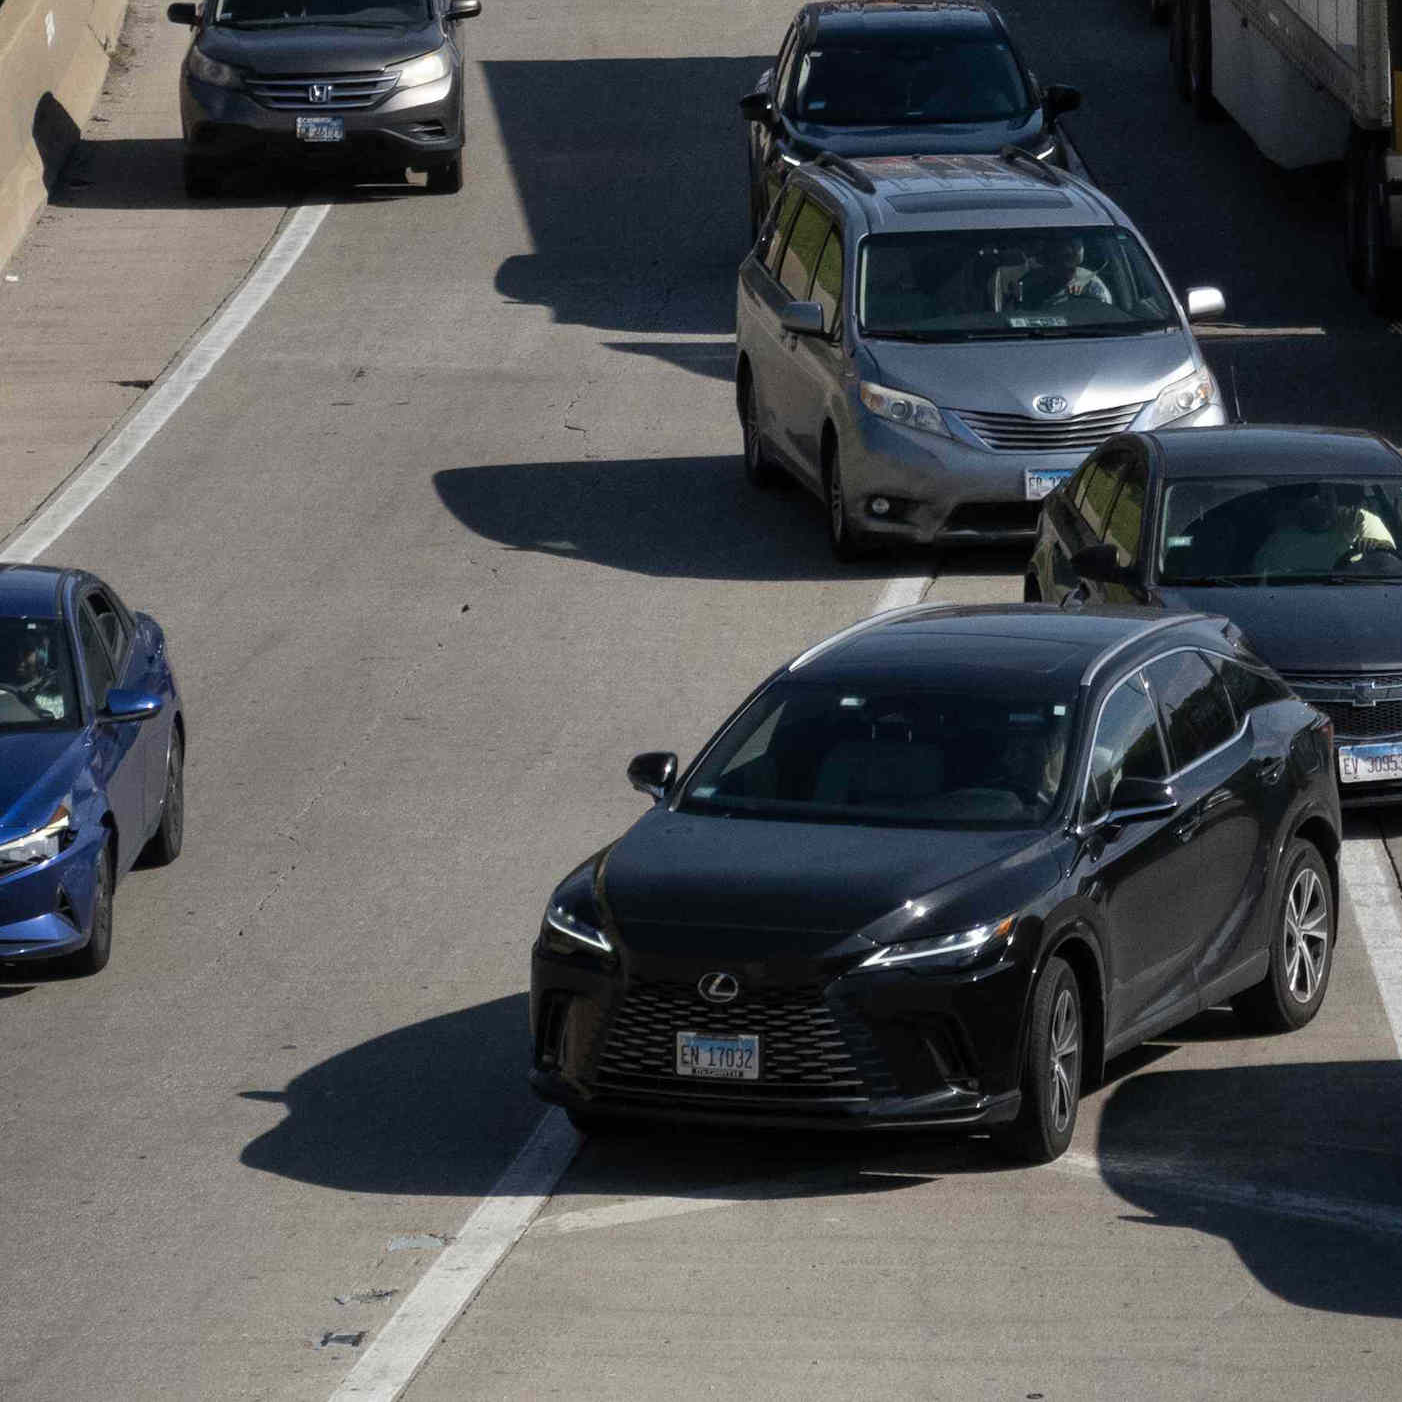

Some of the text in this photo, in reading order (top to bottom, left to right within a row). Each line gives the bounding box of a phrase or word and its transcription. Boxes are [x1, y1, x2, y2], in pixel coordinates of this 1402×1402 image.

[1344, 757, 1359, 775] EV
[681, 1045, 753, 1069] EN 17032
